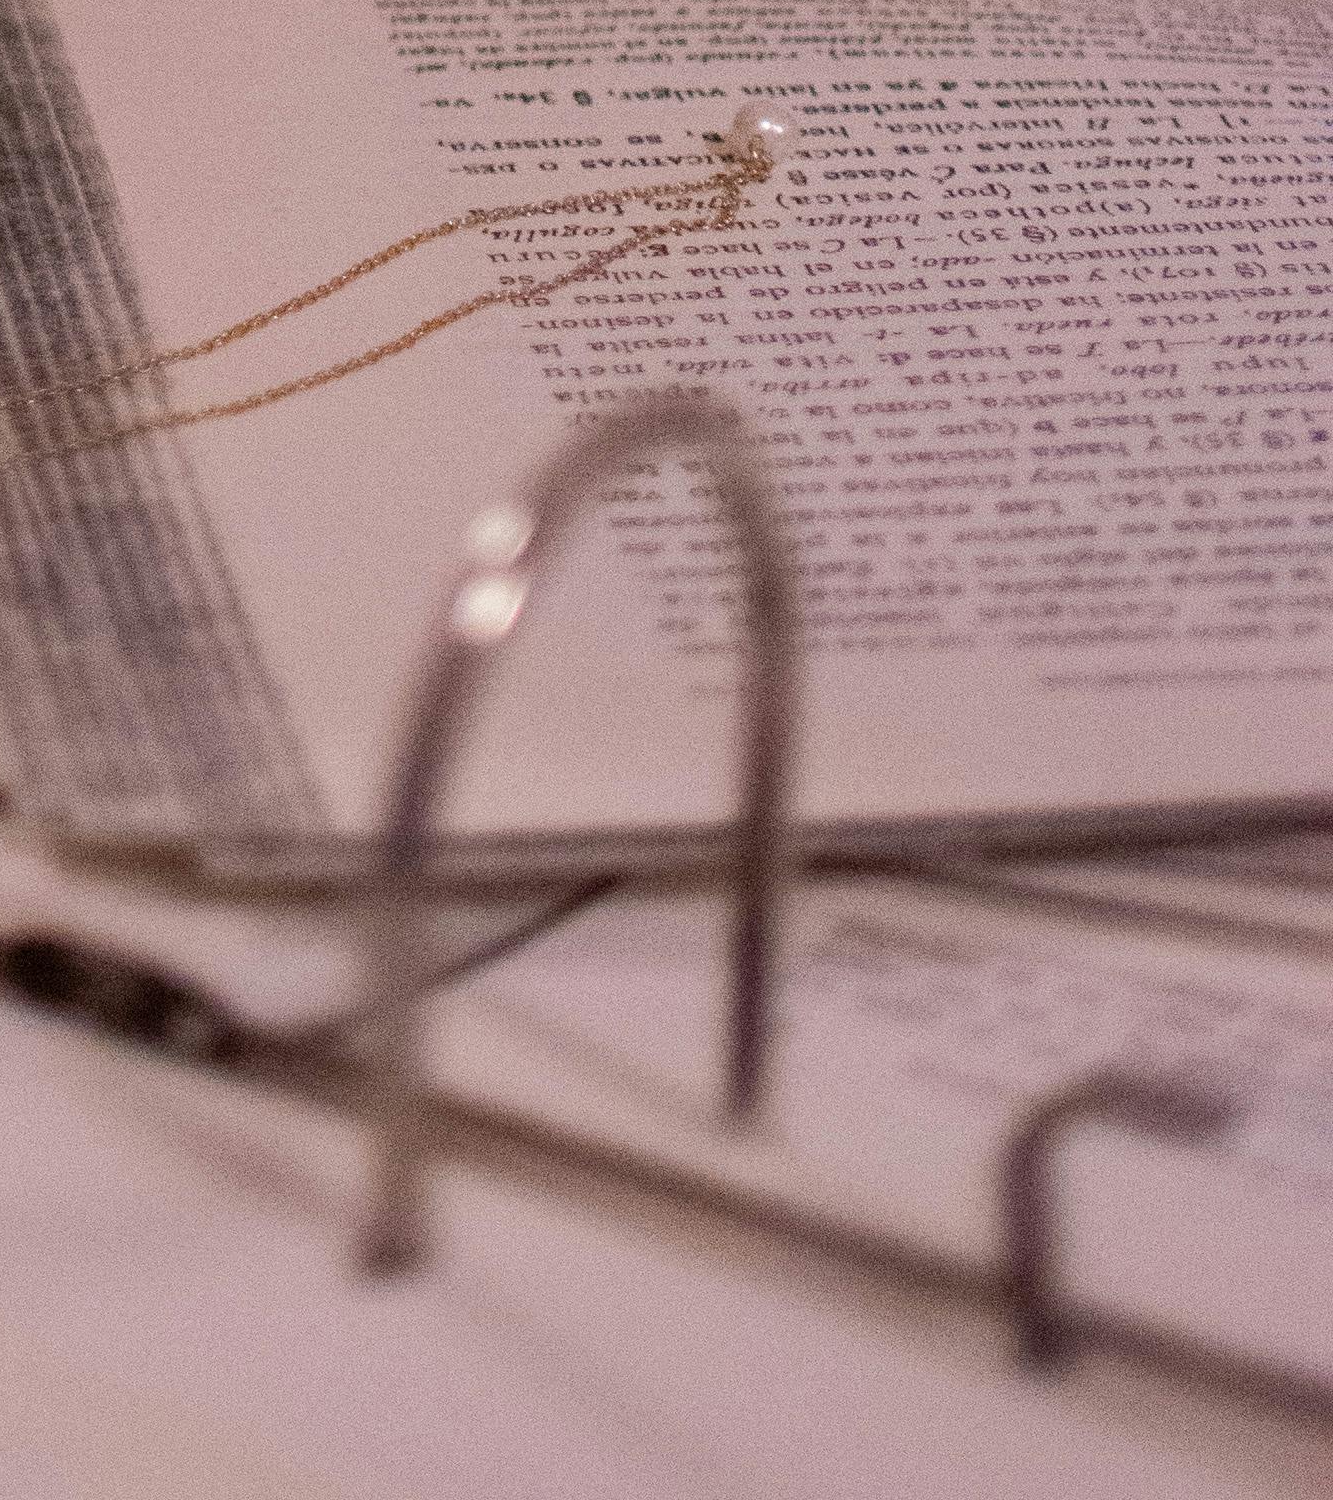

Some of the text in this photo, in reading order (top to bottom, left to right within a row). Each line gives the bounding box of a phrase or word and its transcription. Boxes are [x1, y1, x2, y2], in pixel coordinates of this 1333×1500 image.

[823, 168, 918, 181] véase
[972, 162, 1051, 174] Para
[943, 183, 1011, 200] (por
[775, 190, 920, 209] vesica)
[683, 242, 763, 255] hace
[774, 241, 810, 251] se
[821, 239, 846, 254] C
[860, 236, 905, 250] La
[1232, 243, 1264, 256] la
[1275, 240, 1318, 251] en
[1011, 245, 1219, 265] terminación
[804, 263, 833, 276] el
[853, 259, 895, 270] en
[687, 265, 785, 280] habla
[1088, 268, 1107, 282] y
[805, 277, 928, 296] peligro
[944, 278, 986, 288] en
[1001, 274, 1070, 289] está
[574, 286, 726, 305] perderse
[749, 287, 790, 301] de
[1057, 295, 1102, 308] ha
[753, 309, 794, 321] en
[810, 298, 1043, 321] desaparecido
[696, 312, 729, 326] la
[1138, 313, 1218, 328] rota
[734, 331, 835, 346] latina
[928, 325, 978, 339] La
[530, 343, 562, 357] la
[587, 337, 708, 354] resulta
[1025, 344, 1063, 355] se
[927, 346, 1011, 360] hace
[773, 354, 854, 369] vita
[1213, 355, 1309, 372] lupu
[1141, 387, 1186, 400] no
[805, 405, 837, 419] la
[852, 399, 952, 415] como
